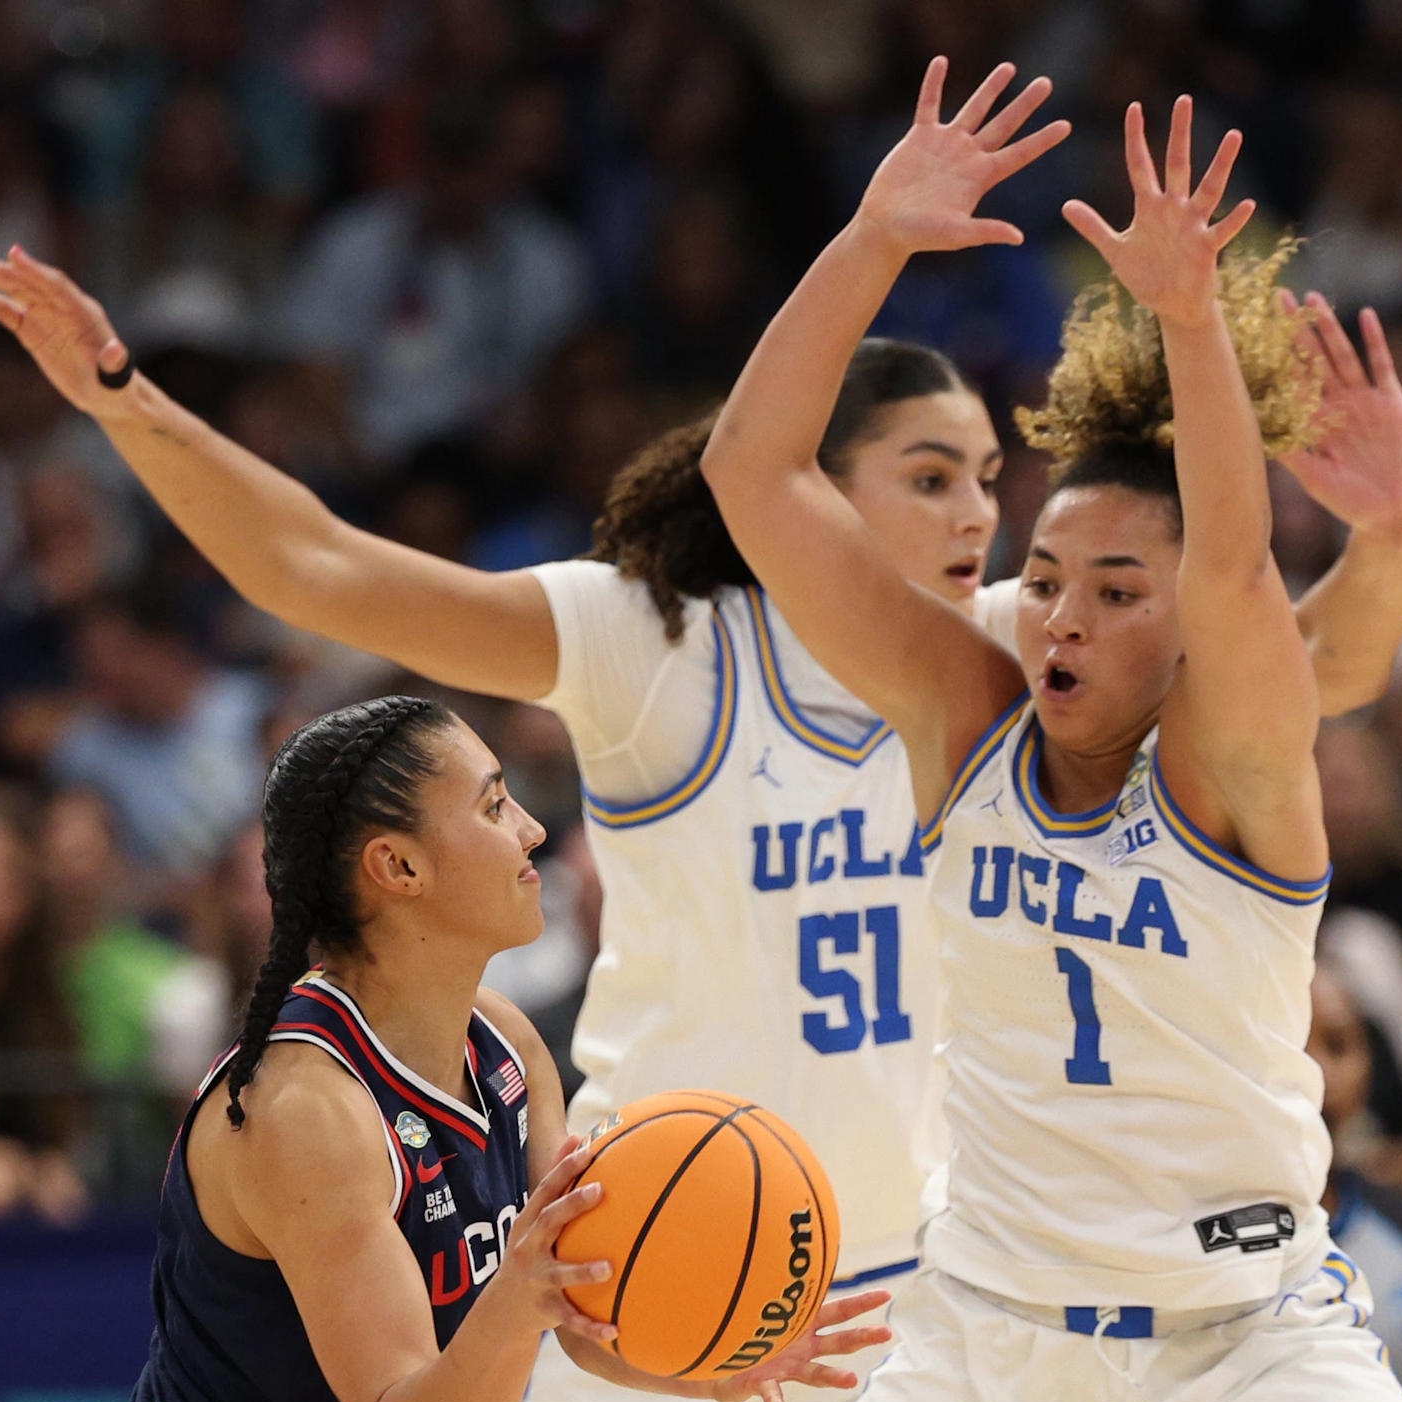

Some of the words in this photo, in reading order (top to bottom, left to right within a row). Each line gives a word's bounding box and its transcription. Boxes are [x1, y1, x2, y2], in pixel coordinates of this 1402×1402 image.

[969, 846, 1189, 958] UCLA
[799, 904, 913, 1055] 51
[1054, 946, 1113, 1086] 1
[426, 1190, 443, 1208] BE
[713, 1208, 813, 1372] Wilson
